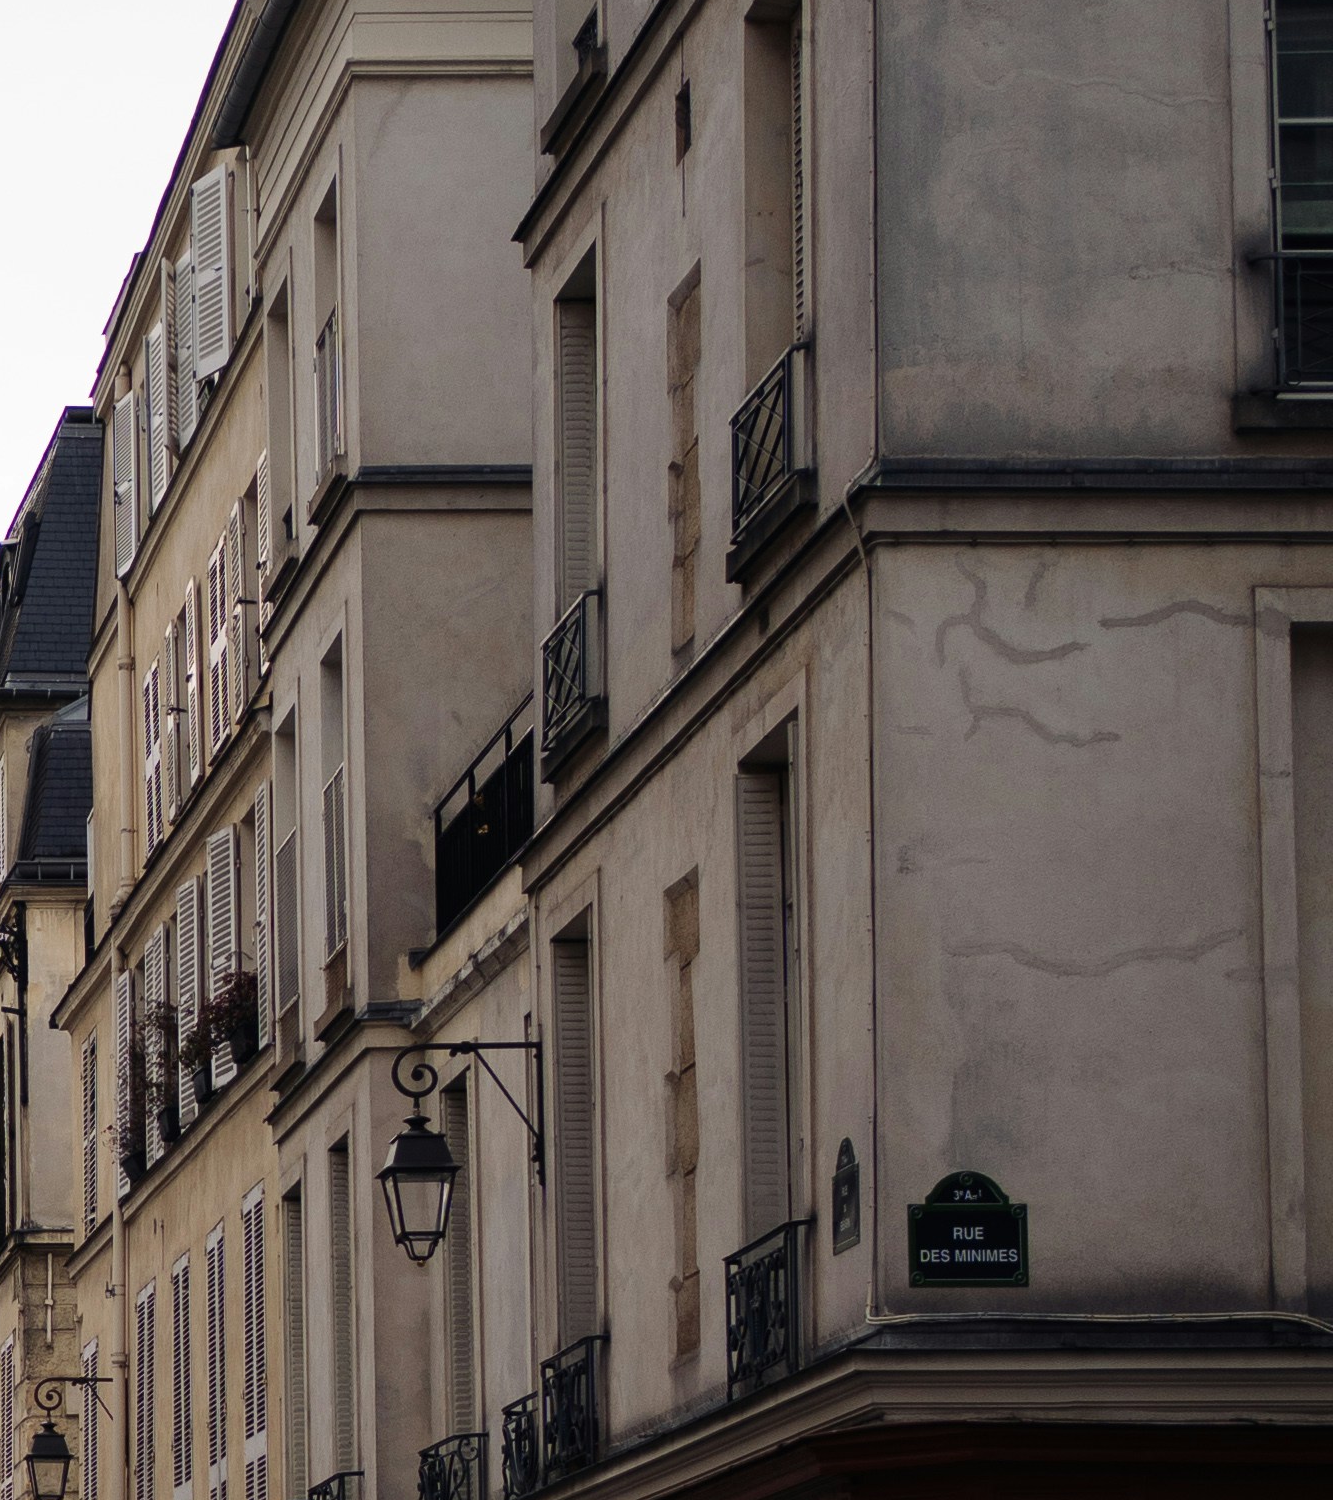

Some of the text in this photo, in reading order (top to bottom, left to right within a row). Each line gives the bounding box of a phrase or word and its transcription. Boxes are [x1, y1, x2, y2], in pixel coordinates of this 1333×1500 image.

[953, 1227, 984, 1240] RUE
[920, 1249, 1018, 1262] DES MINIMES
